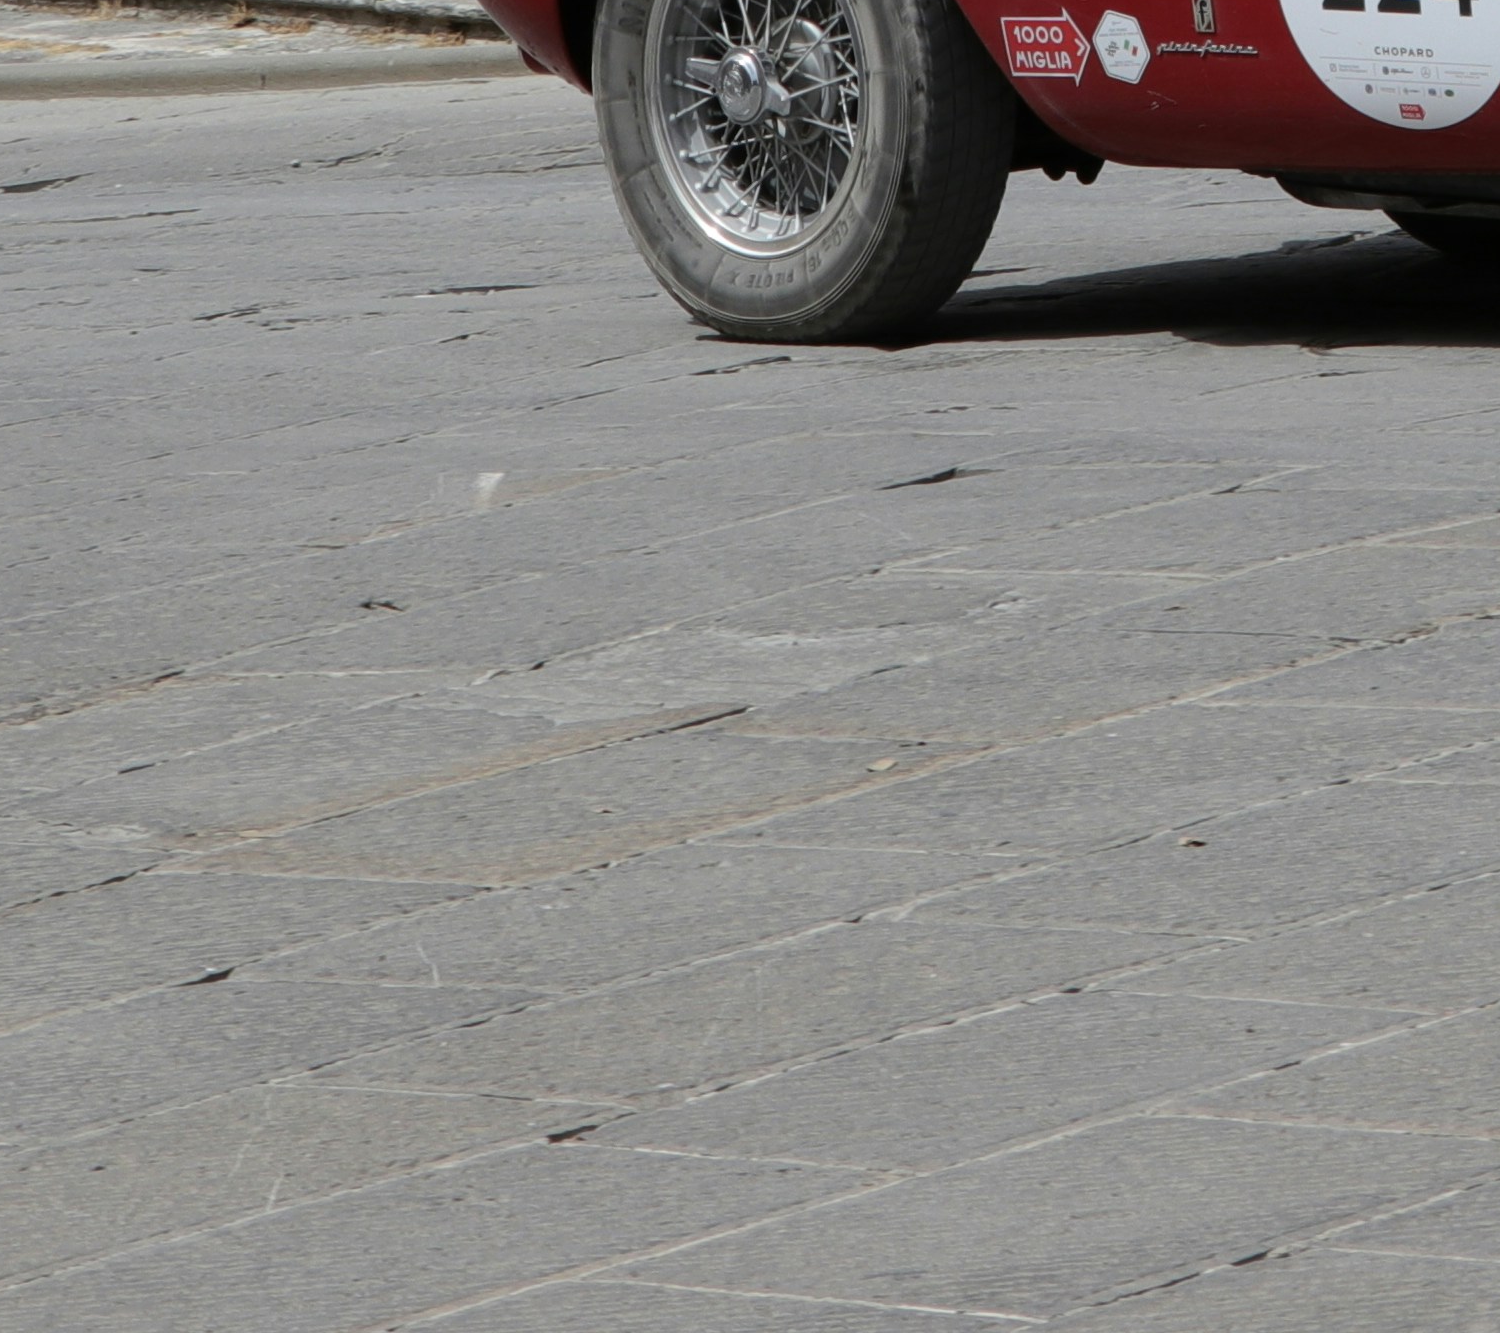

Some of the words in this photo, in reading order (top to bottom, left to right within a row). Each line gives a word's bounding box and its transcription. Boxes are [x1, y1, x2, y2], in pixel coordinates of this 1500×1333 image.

[1013, 25, 1064, 44] 1000
[1016, 50, 1073, 70] MIGLIA
[1374, 46, 1434, 58] CHOPARD
